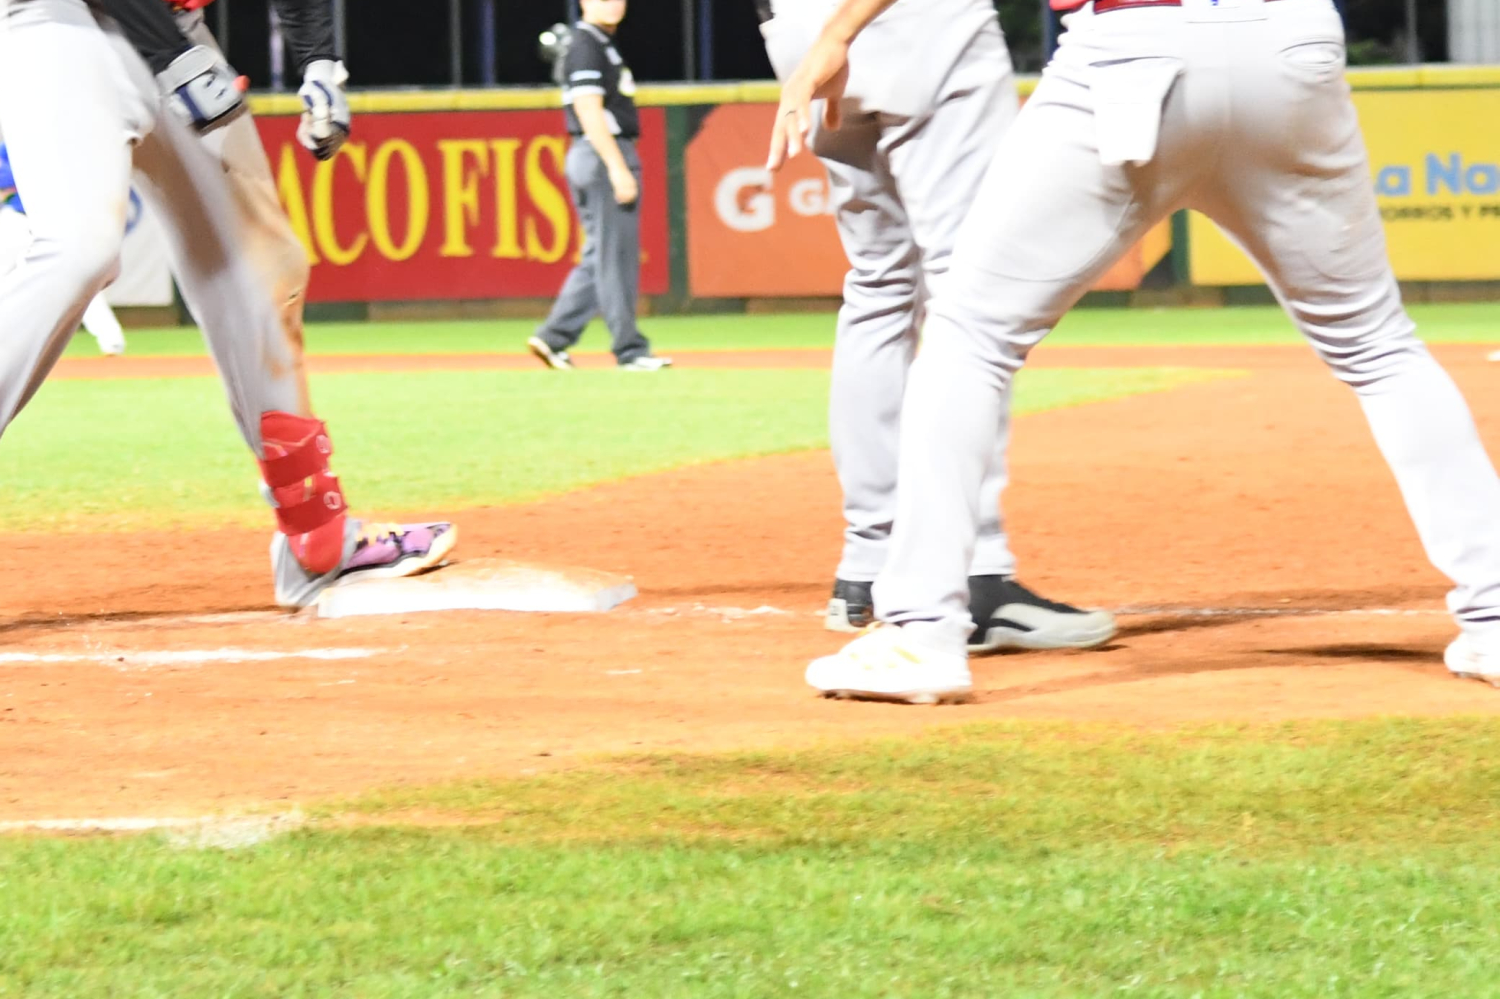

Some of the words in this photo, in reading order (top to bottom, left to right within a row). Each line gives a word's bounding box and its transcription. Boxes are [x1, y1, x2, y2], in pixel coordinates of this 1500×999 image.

[277, 138, 429, 266] ACO
[437, 135, 586, 265] FIS
[714, 165, 775, 232] G
